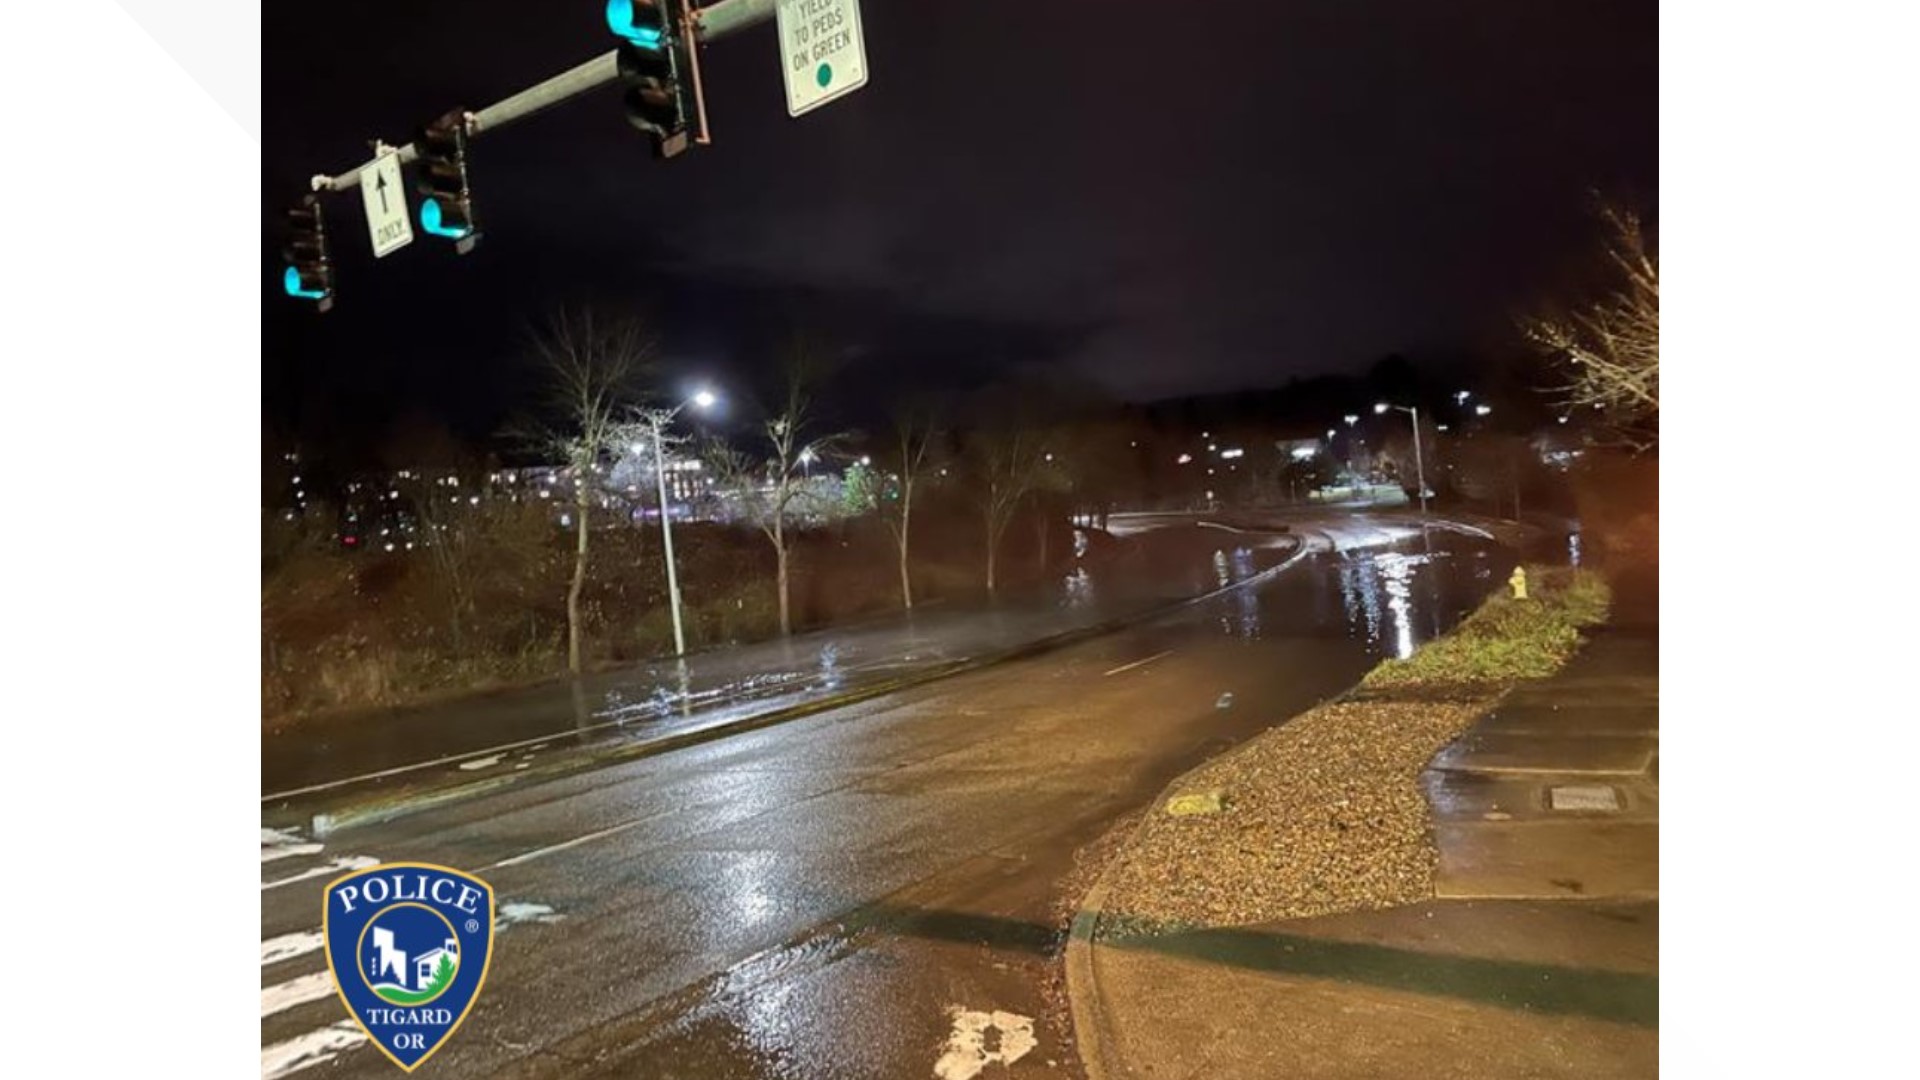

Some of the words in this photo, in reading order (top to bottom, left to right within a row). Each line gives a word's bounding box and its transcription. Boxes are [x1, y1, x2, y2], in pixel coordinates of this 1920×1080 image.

[795, 26, 809, 46] TO
[812, 8, 843, 37] PEDS
[793, 50, 809, 71] ON
[812, 28, 851, 61] GREEN
[378, 218, 406, 246] ONLY
